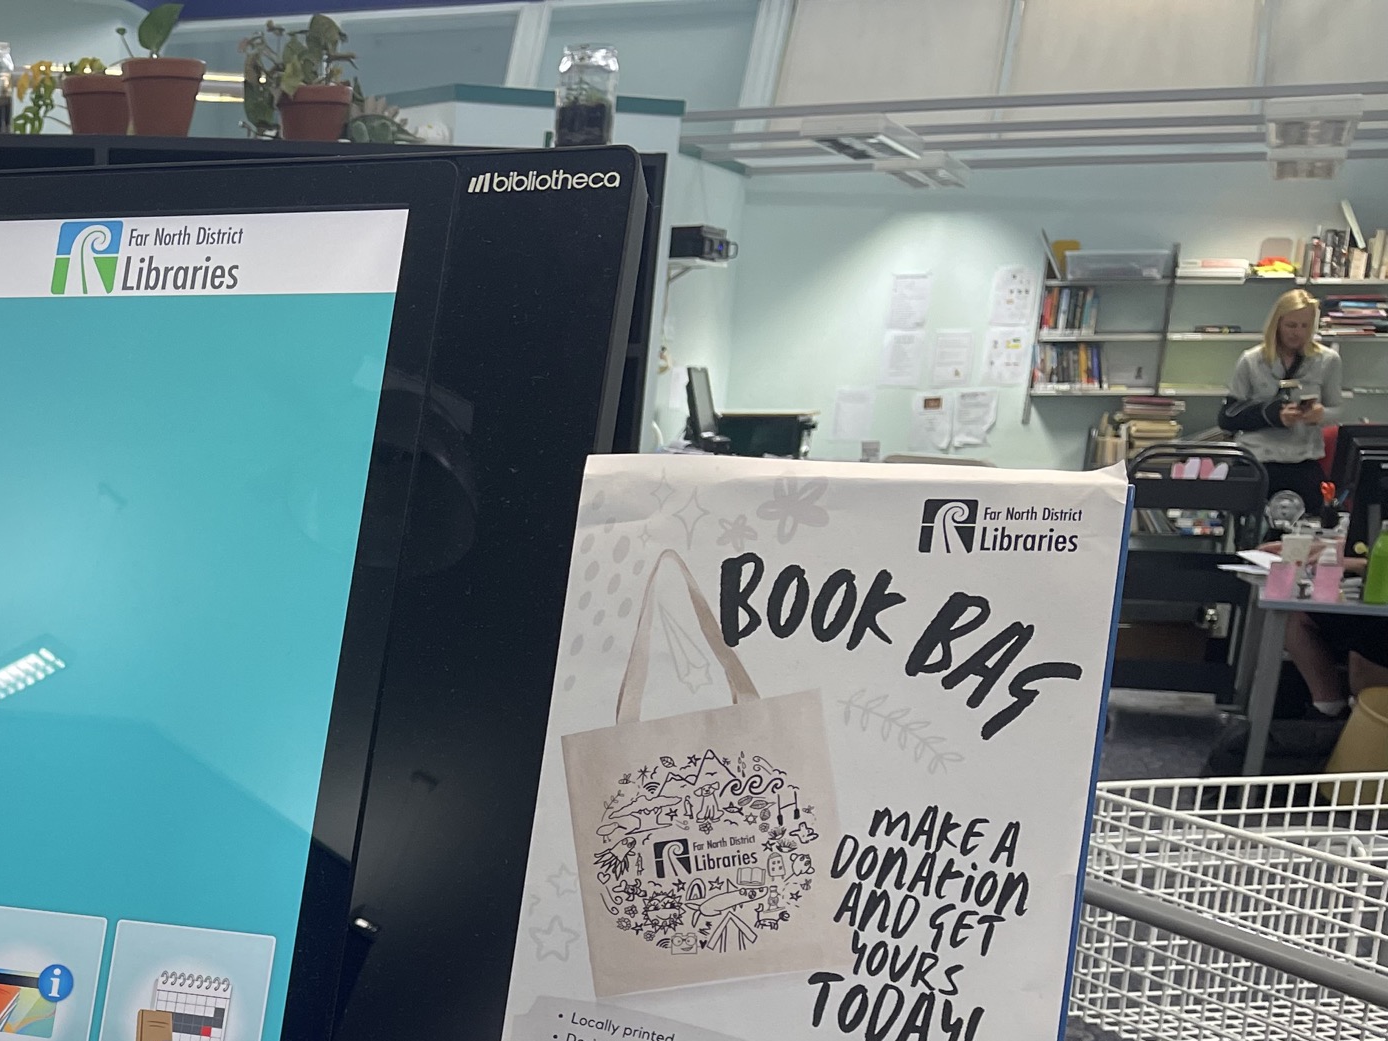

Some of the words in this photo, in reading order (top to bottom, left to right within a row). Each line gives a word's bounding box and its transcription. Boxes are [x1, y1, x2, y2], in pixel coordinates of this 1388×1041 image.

[492, 168, 620, 192] bibliotheca
[128, 228, 151, 247] Far
[154, 226, 193, 247] North
[196, 226, 244, 247] District
[121, 256, 239, 292] Libraries
[983, 507, 1001, 521] Far
[1005, 507, 1039, 521] North
[1043, 507, 1083, 522] District
[979, 526, 1079, 553] Libraries
[719, 551, 907, 652] BOOK
[904, 591, 1084, 741] BAG
[692, 842, 705, 851] Far
[707, 838, 727, 849] North
[729, 835, 756, 846] District
[990, 821, 1021, 868] A
[694, 850, 758, 872] Libraries
[929, 903, 1006, 957] GET
[852, 930, 964, 996] YOURS
[570, 1011, 620, 1035] Locally
